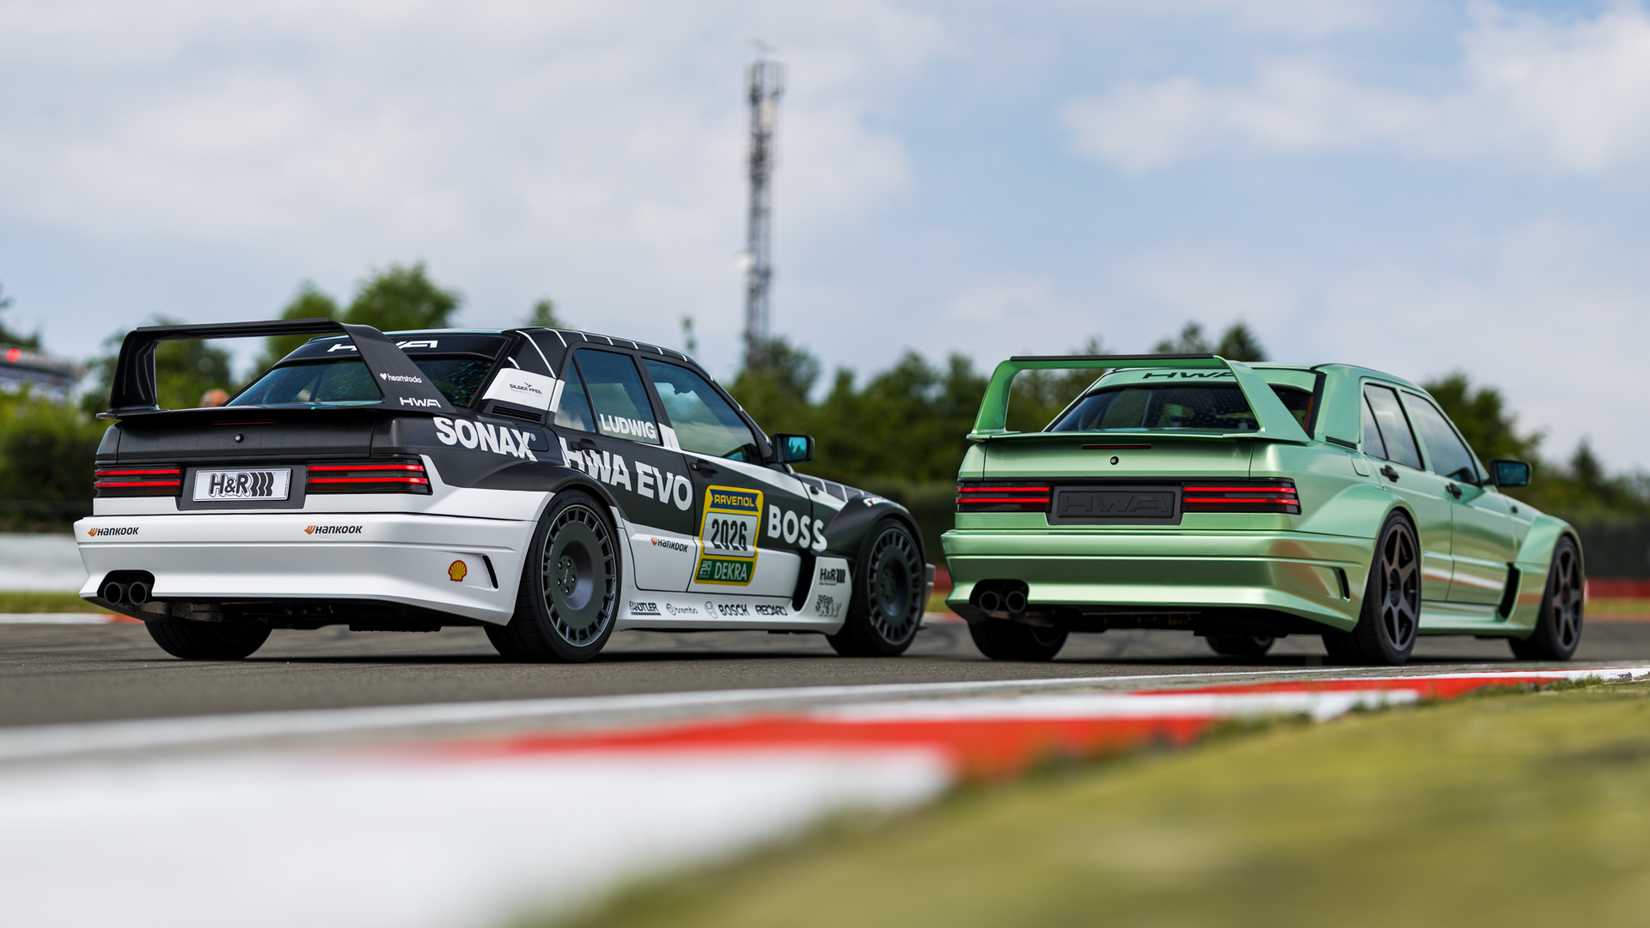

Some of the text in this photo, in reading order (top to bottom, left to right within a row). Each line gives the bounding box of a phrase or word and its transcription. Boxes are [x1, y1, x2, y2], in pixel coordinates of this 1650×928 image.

[327, 340, 439, 352] HA
[400, 397, 441, 408] HWA
[600, 414, 656, 440] LUDWIG
[558, 436, 693, 512] HWA EVO
[208, 472, 252, 497] H&R
[713, 494, 755, 508] RAVENOL
[1063, 495, 1168, 513] HWA
[710, 518, 748, 551] 2026
[767, 504, 828, 554] BOSS
[714, 562, 748, 582] DEKRA
[718, 603, 750, 616] BOSCH
[754, 604, 789, 617] RECARO
